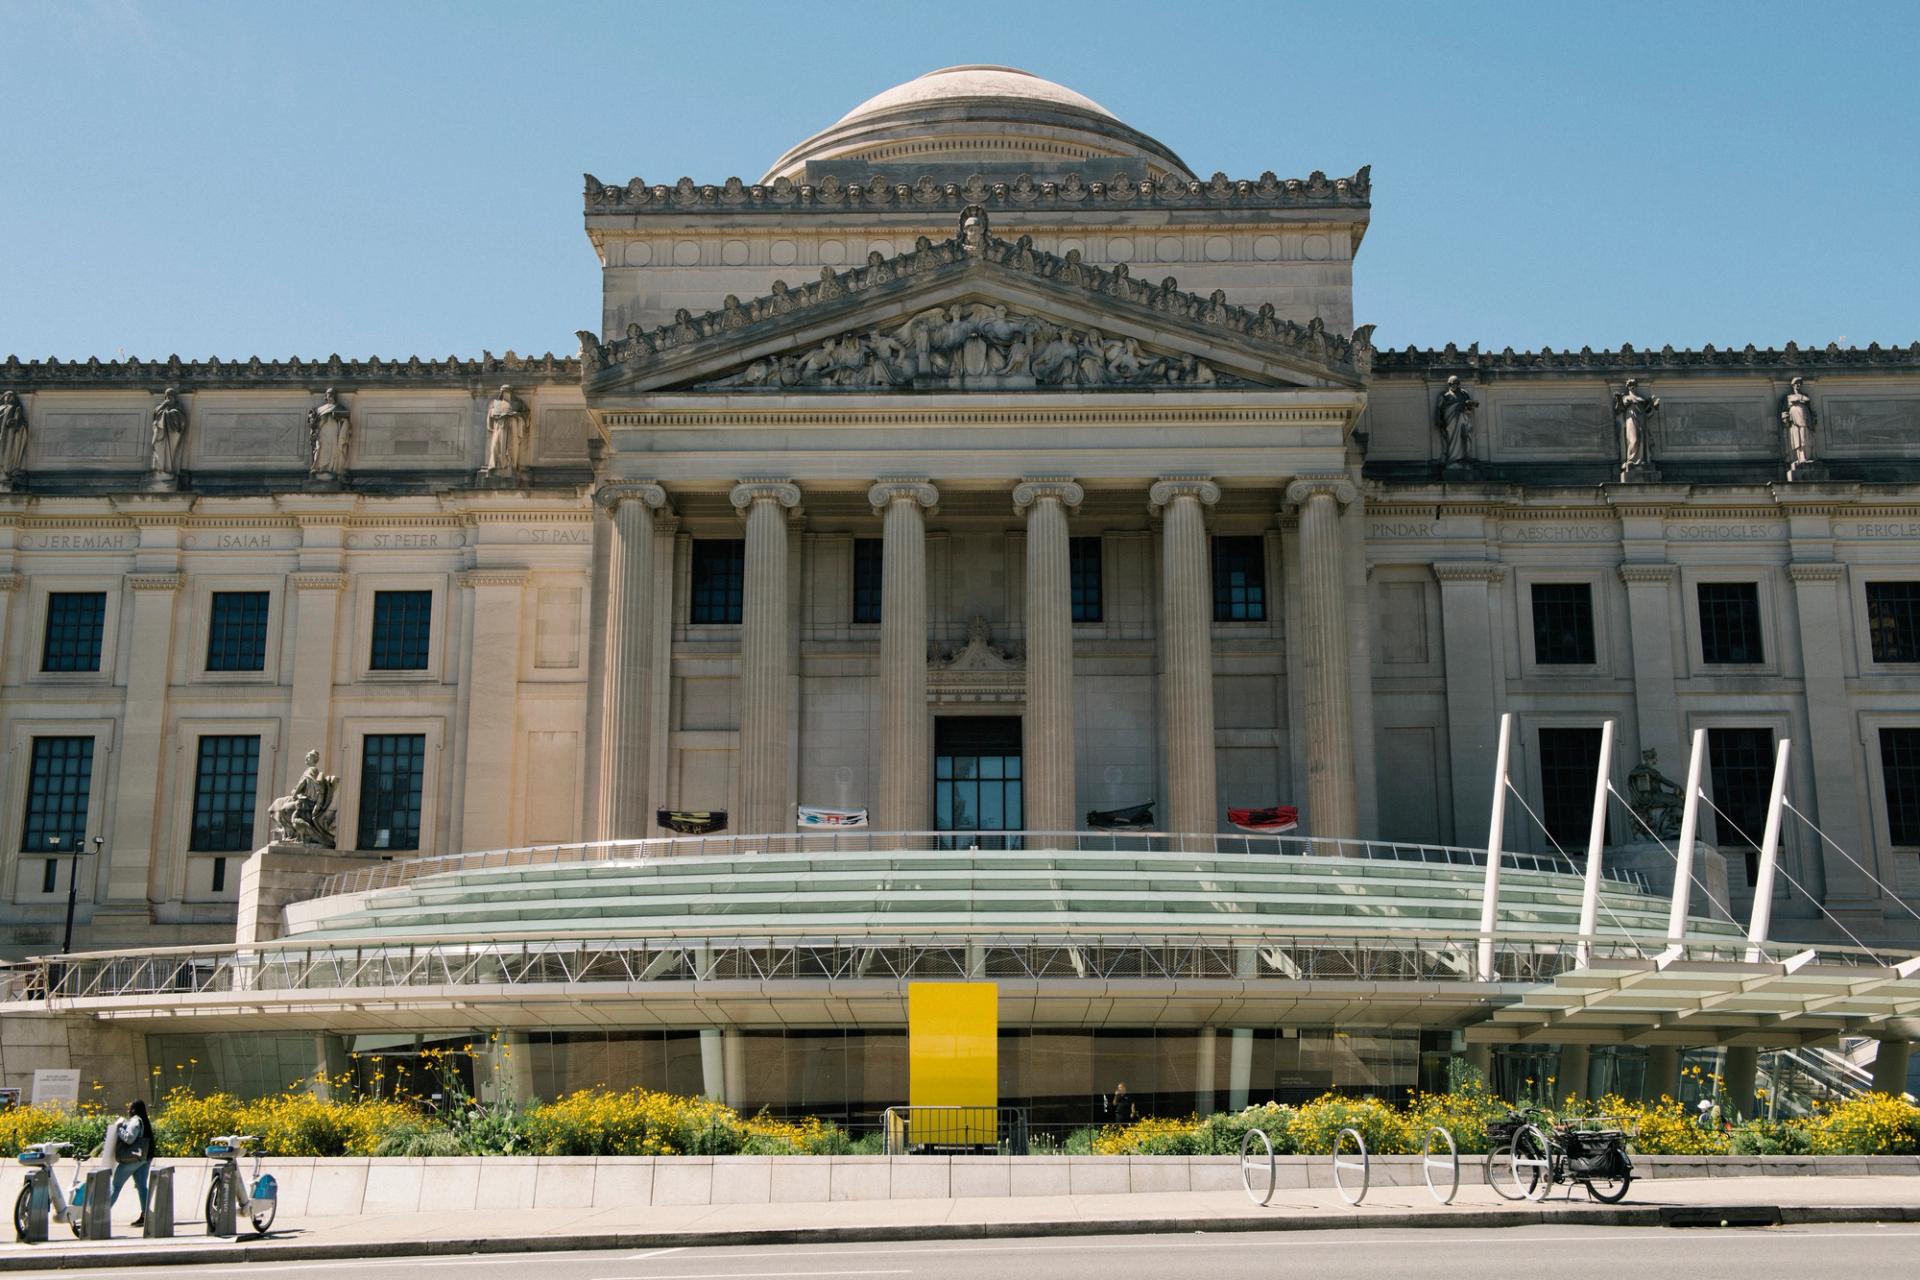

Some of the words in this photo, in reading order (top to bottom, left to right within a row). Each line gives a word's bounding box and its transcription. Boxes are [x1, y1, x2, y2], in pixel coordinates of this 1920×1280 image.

[1371, 523, 1430, 537] PINDAR
[1516, 526, 1599, 540] AESCHYLVS
[1680, 524, 1767, 538] SOPHOCLES
[39, 535, 123, 549] JEREMIAH
[217, 535, 272, 548] ISAIAH
[395, 534, 438, 547] PETER
